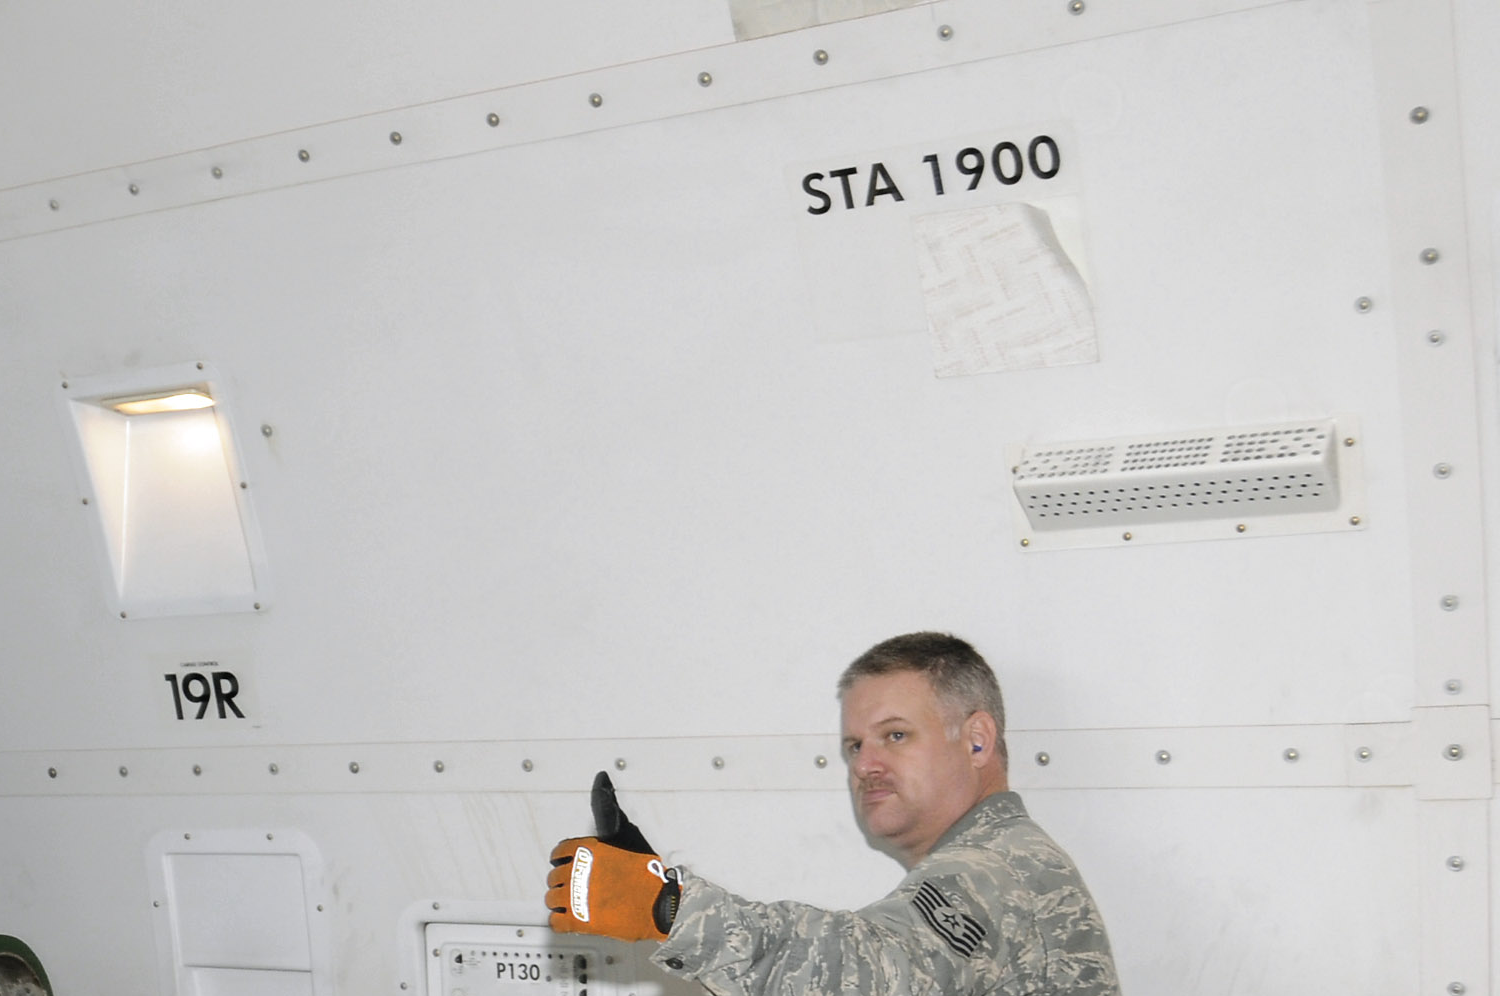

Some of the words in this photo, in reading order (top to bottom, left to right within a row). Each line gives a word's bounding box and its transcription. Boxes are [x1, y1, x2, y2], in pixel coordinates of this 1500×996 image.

[802, 162, 905, 216] STA
[922, 135, 1061, 196] 1900
[164, 671, 246, 720] 19R
[496, 962, 541, 981] P130
